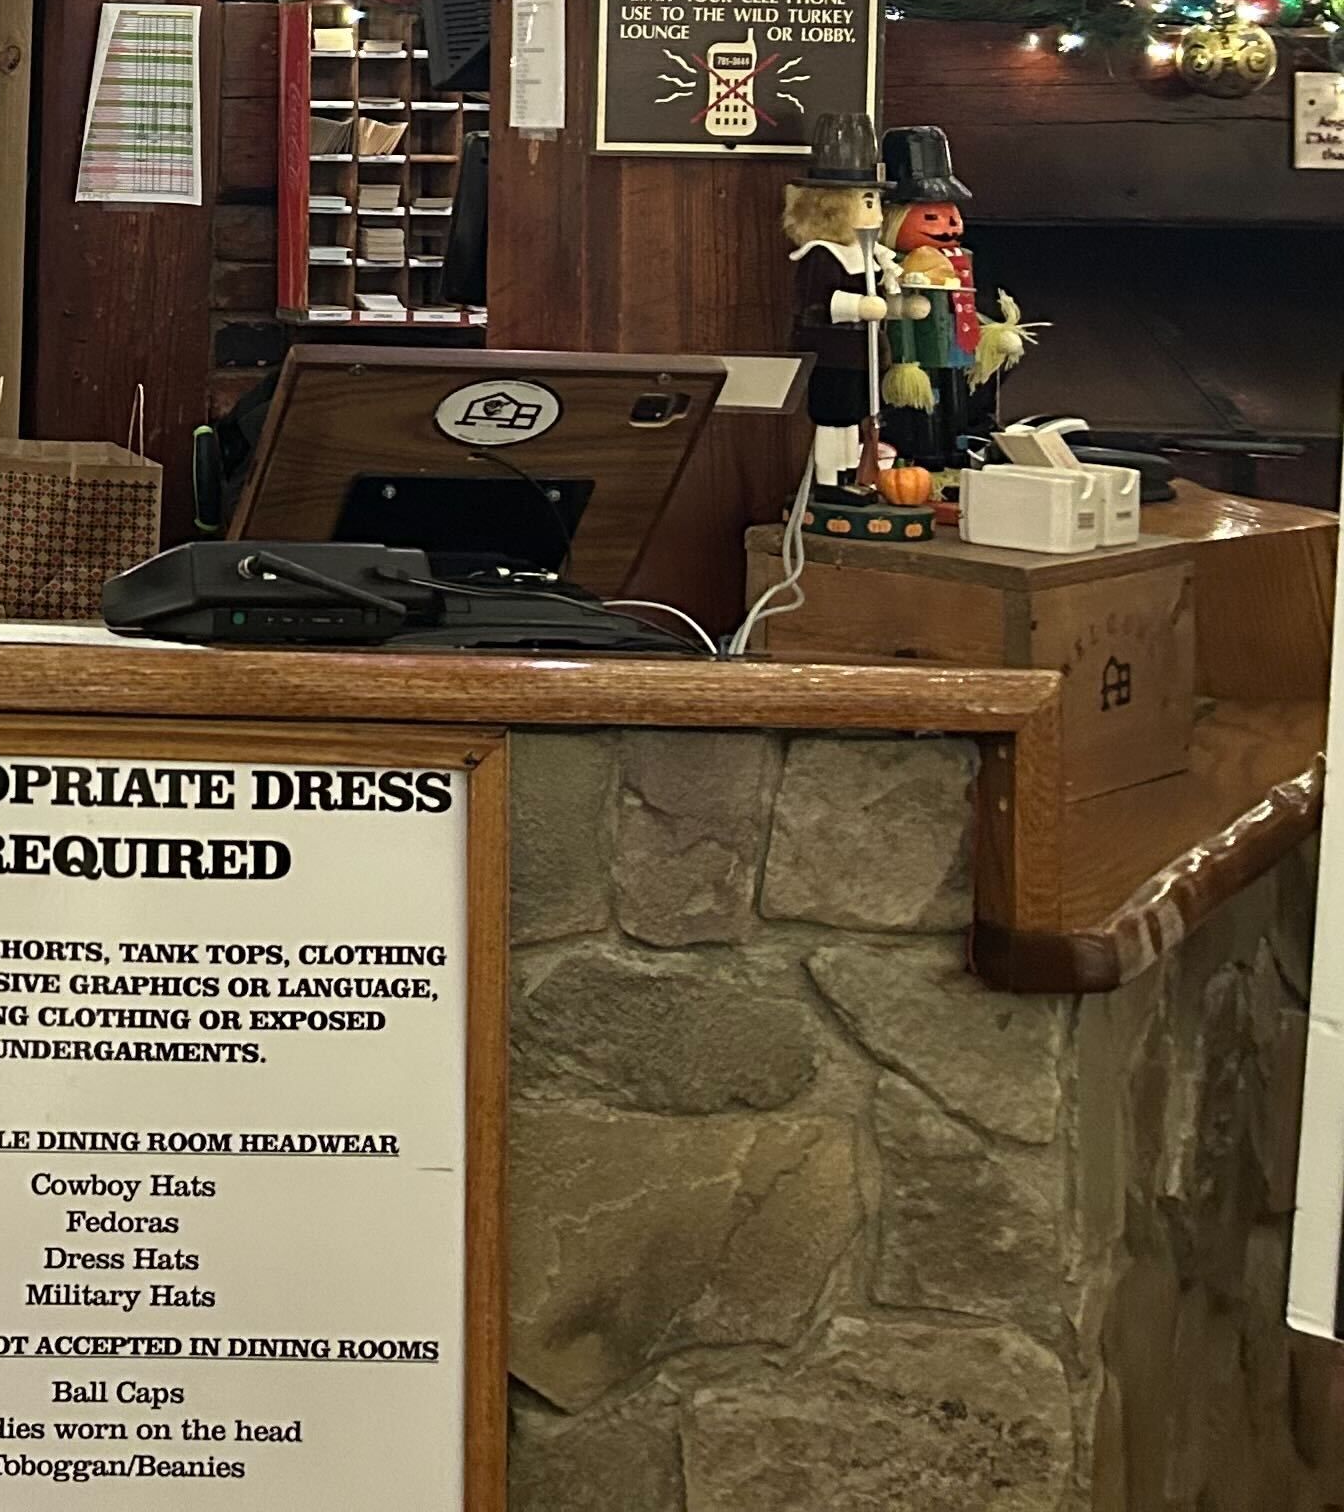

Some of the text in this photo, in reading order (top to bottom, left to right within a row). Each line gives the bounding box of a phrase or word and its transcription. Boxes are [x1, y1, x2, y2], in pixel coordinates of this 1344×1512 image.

[622, 6, 853, 24] USE TO THE WILD TURKEY
[620, 24, 855, 43] LOUNGE OR LOBBY.
[252, 771, 451, 813] DRESS
[119, 944, 199, 963] TANK
[206, 945, 289, 967] TOPS,
[299, 945, 446, 966] CLOTHING
[70, 975, 219, 997] GRAPHICS
[228, 978, 270, 997] OR
[278, 978, 437, 1001] LANGUAGE,
[39, 1007, 191, 1029] CLOTHING
[200, 1010, 242, 1030] OR
[250, 1011, 385, 1030] EXPOSED
[37, 1131, 140, 1152] DINING
[147, 1133, 232, 1154] ROOM
[239, 1133, 400, 1154] HEADWEAR
[32, 1173, 215, 1202] Cowboy Hats
[66, 1211, 178, 1233] Fedoras
[44, 1248, 199, 1270] Dress Hats
[26, 1284, 215, 1312] Military Hats
[35, 1336, 182, 1358] ACCEPTED
[188, 1337, 221, 1358] IN
[227, 1338, 330, 1360] DINING
[336, 1339, 440, 1361] ROOMS
[52, 1381, 184, 1409] Ball Caps
[54, 1424, 128, 1439] worn
[137, 1424, 172, 1440] on
[182, 1419, 226, 1441] the
[235, 1420, 302, 1442] head
